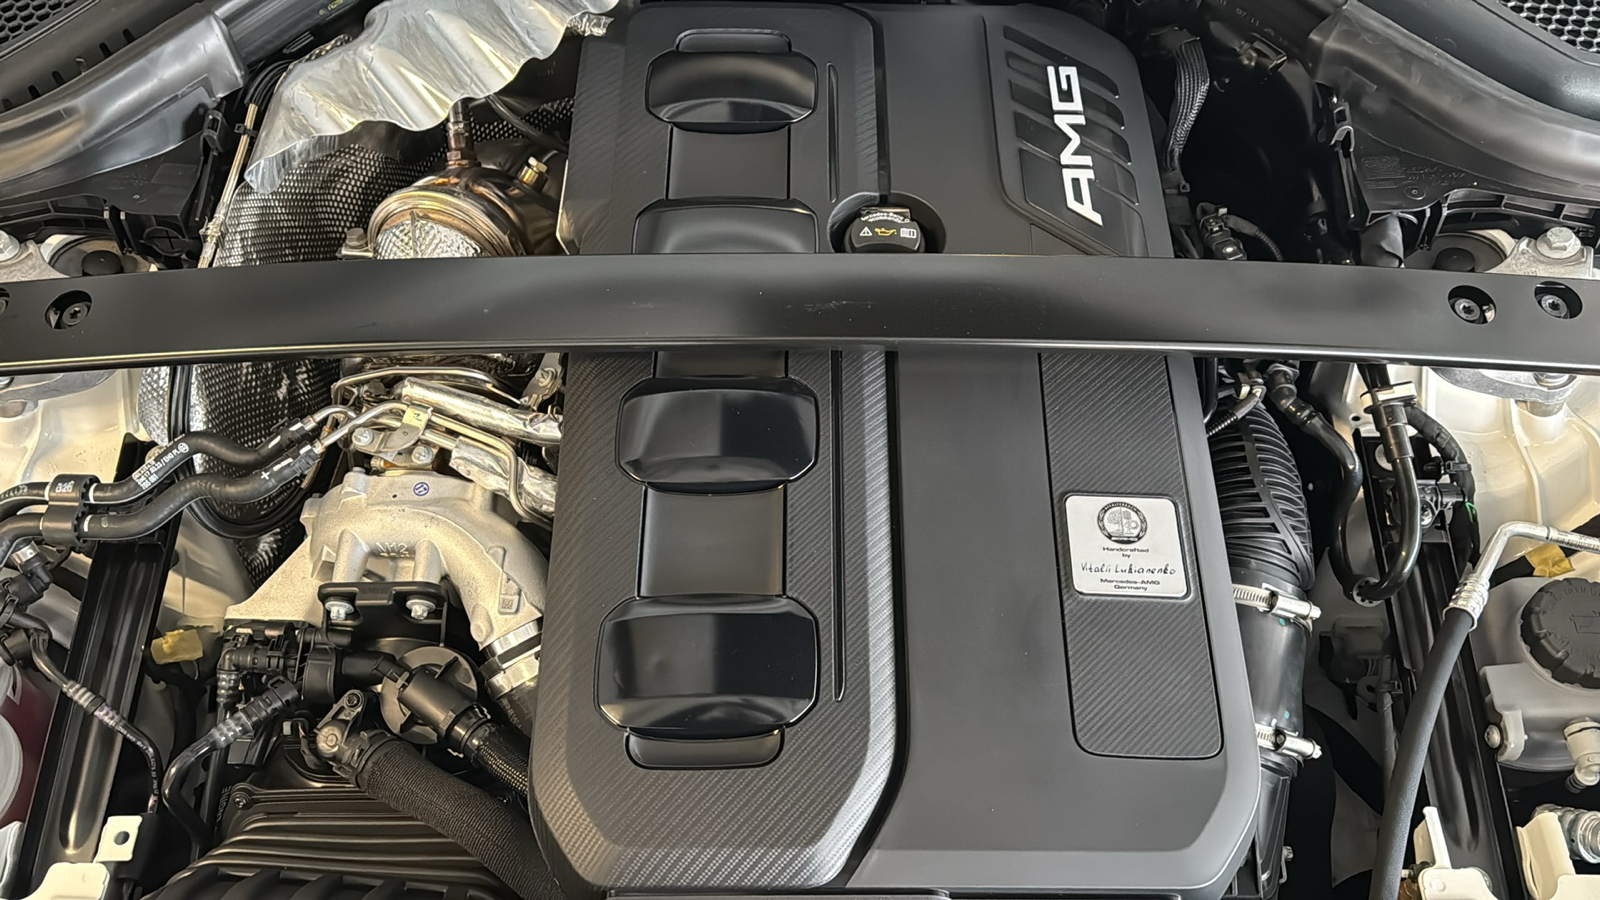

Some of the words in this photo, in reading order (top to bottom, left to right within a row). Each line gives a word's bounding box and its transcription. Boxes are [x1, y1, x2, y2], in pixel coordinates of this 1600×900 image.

[1046, 65, 1104, 227] AMG
[1080, 562, 1111, 574] Vitalii
[1114, 563, 1176, 575] Lukianenko
